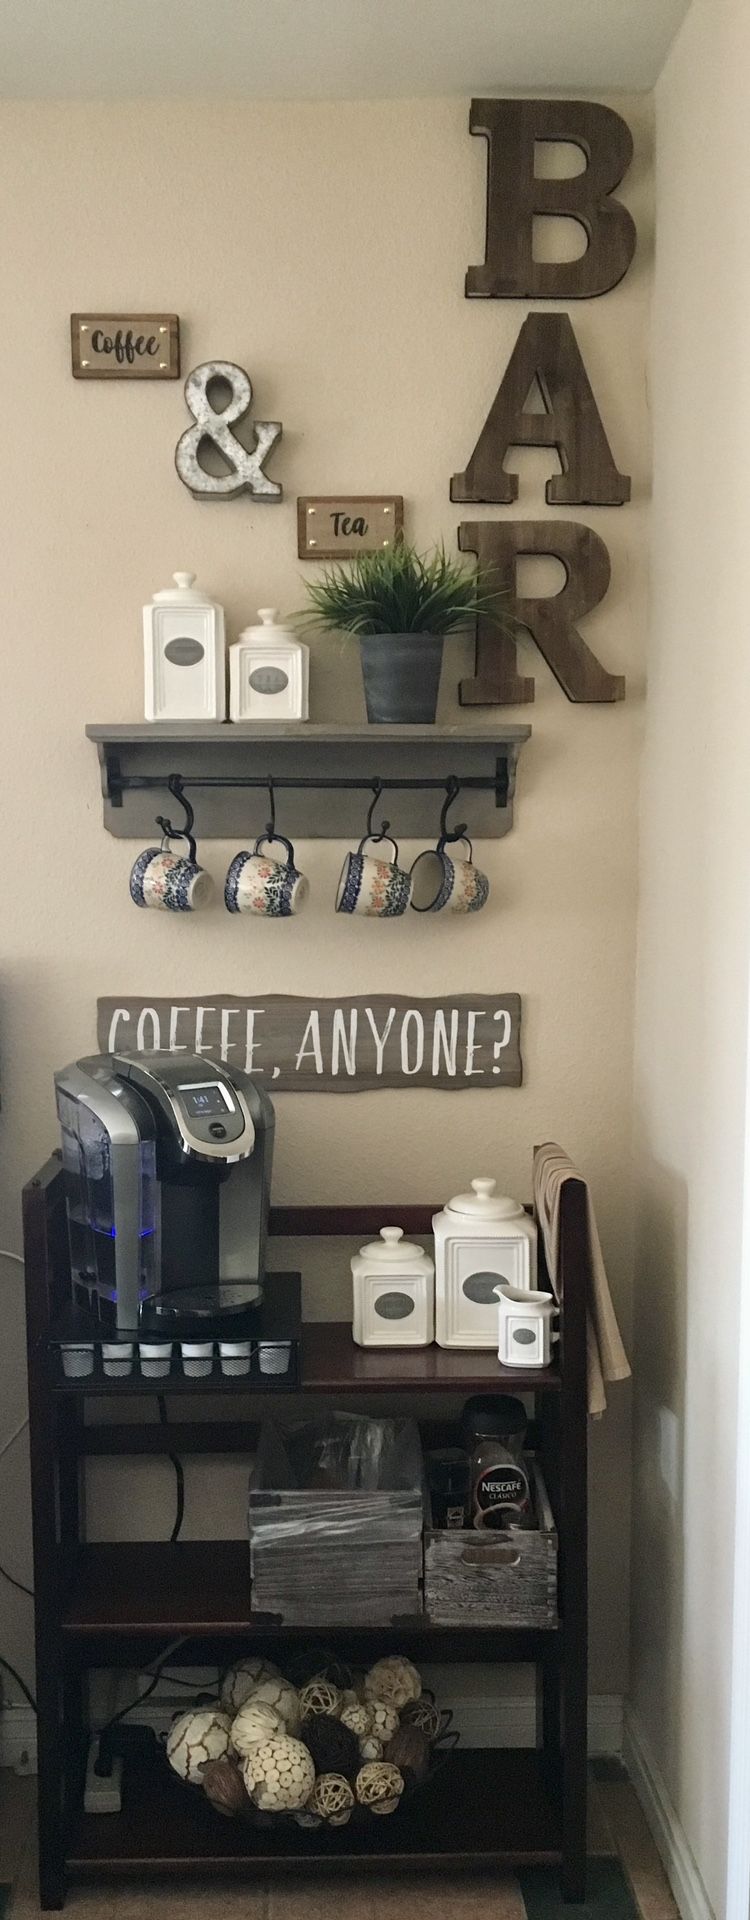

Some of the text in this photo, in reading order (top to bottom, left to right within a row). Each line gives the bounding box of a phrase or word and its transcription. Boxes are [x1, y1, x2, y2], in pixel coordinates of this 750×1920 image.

[91, 330, 160, 364] Coffee
[450, 98, 637, 705] BAR
[330, 512, 368, 537] Tea
[295, 1007, 511, 1076] ANYONE?
